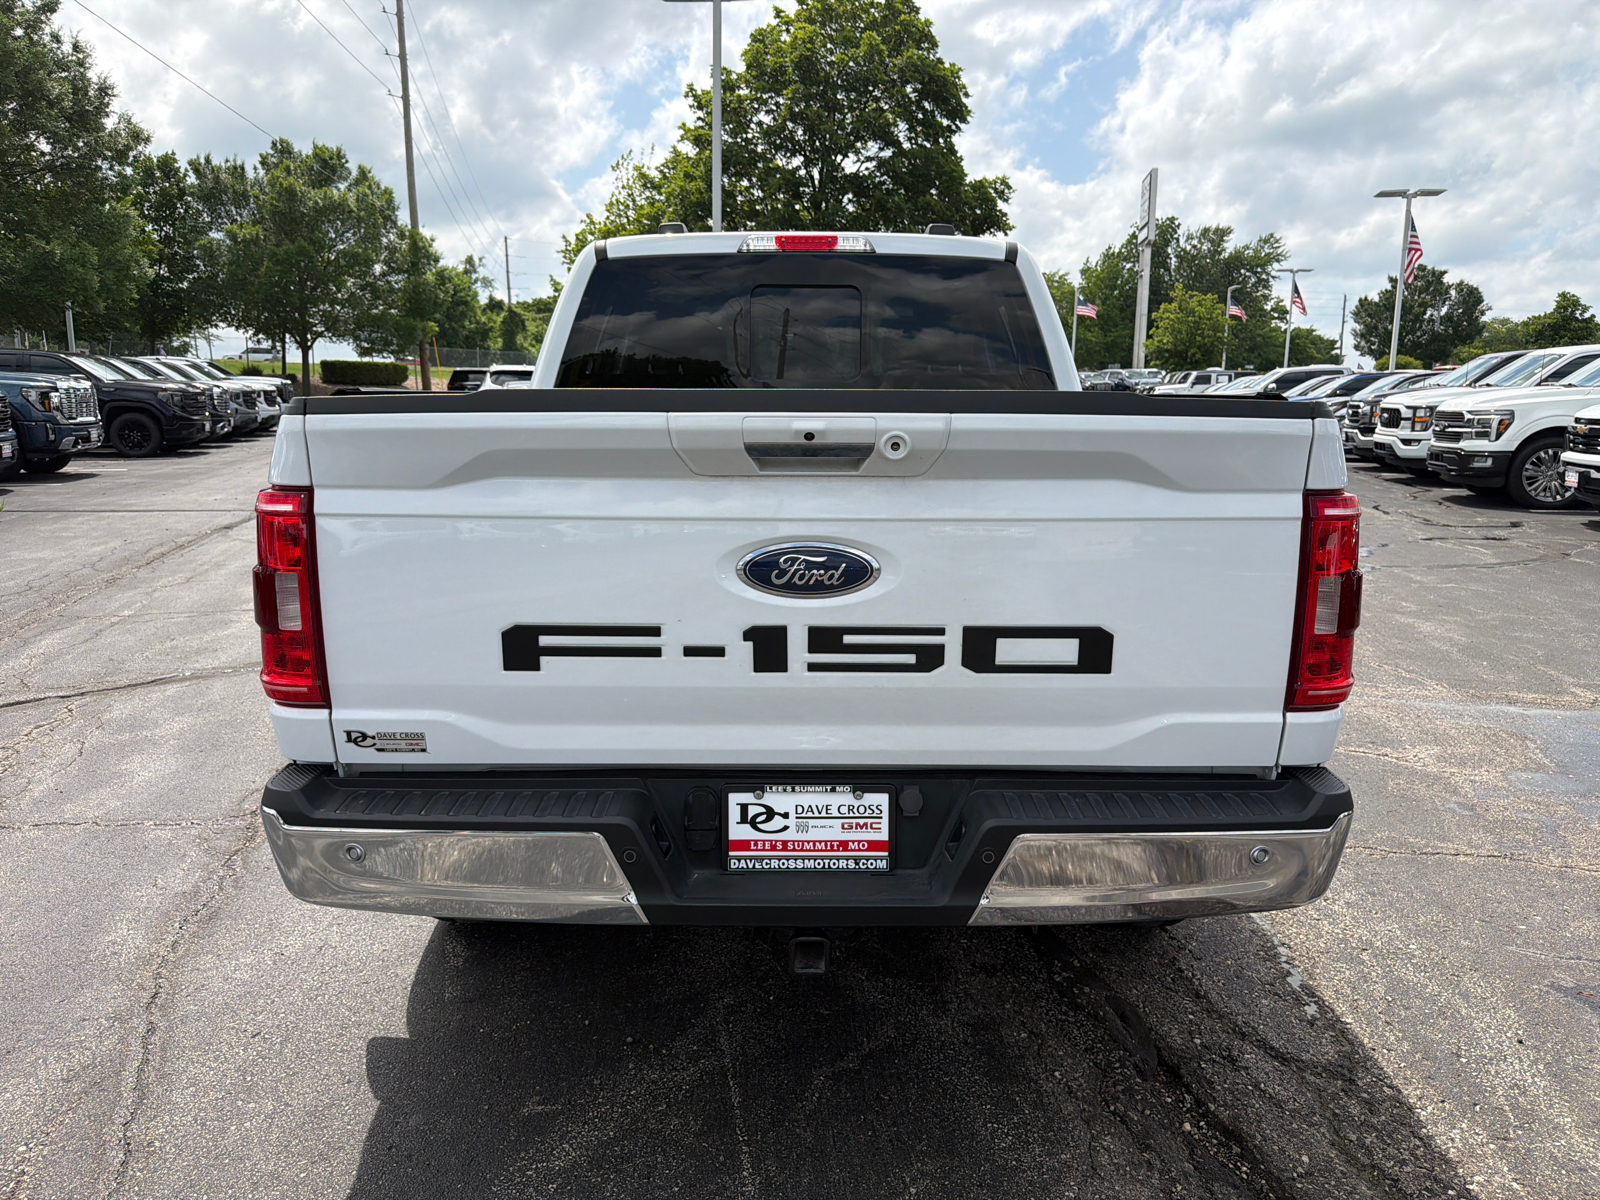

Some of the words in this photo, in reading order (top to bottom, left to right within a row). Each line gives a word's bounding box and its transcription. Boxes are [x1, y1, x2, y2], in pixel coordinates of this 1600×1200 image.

[771, 554, 846, 585] Ford
[501, 623, 1114, 674] F-150
[795, 804, 833, 815] DAVE
[837, 804, 883, 815] CROSS
[841, 821, 882, 830] GMC
[787, 841, 843, 852] SUMMIT,
[847, 841, 868, 850] MO
[730, 859, 887, 869] DAVECROSSMOTORS.COM
